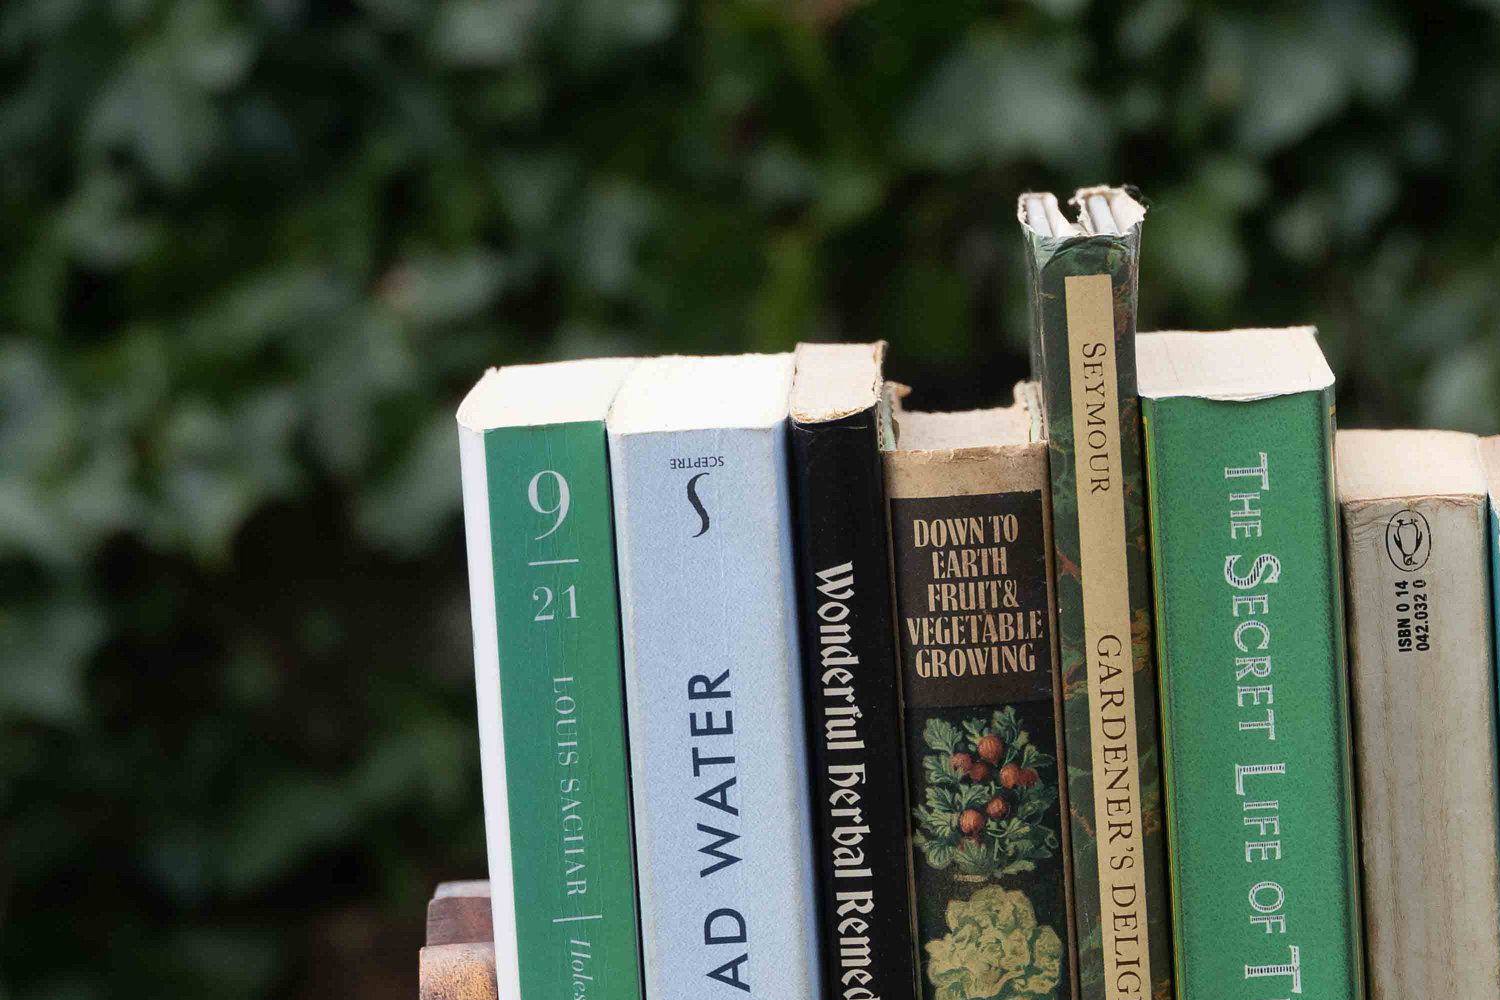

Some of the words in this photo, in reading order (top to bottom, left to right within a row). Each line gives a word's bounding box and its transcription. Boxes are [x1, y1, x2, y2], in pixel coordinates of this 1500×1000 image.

[1081, 342, 1111, 495] SEYMOUR
[669, 455, 726, 471] SCEPTRE
[527, 469, 572, 541] 9
[1224, 452, 1270, 540] THE
[913, 516, 984, 548] DOWN
[988, 513, 1019, 544] TO
[931, 547, 1008, 579] EARTH
[1394, 580, 1409, 597] 14
[1412, 579, 1427, 588] 0
[533, 585, 582, 622] 21
[906, 610, 1043, 646] VEGETABLE
[1396, 603, 1410, 612] 0
[1413, 593, 1430, 651] 042.032
[814, 561, 865, 751] Wonderful
[915, 643, 1036, 678] GROWING
[1223, 553, 1281, 741] SECRET
[1396, 618, 1412, 653] ISBN
[553, 676, 580, 767] LOUIS
[688, 669, 743, 877] WATER
[1096, 633, 1135, 871] GARDENER'S
[560, 778, 588, 897] SACHAR
[1235, 763, 1286, 863] LIFE
[1248, 881, 1287, 934] OF
